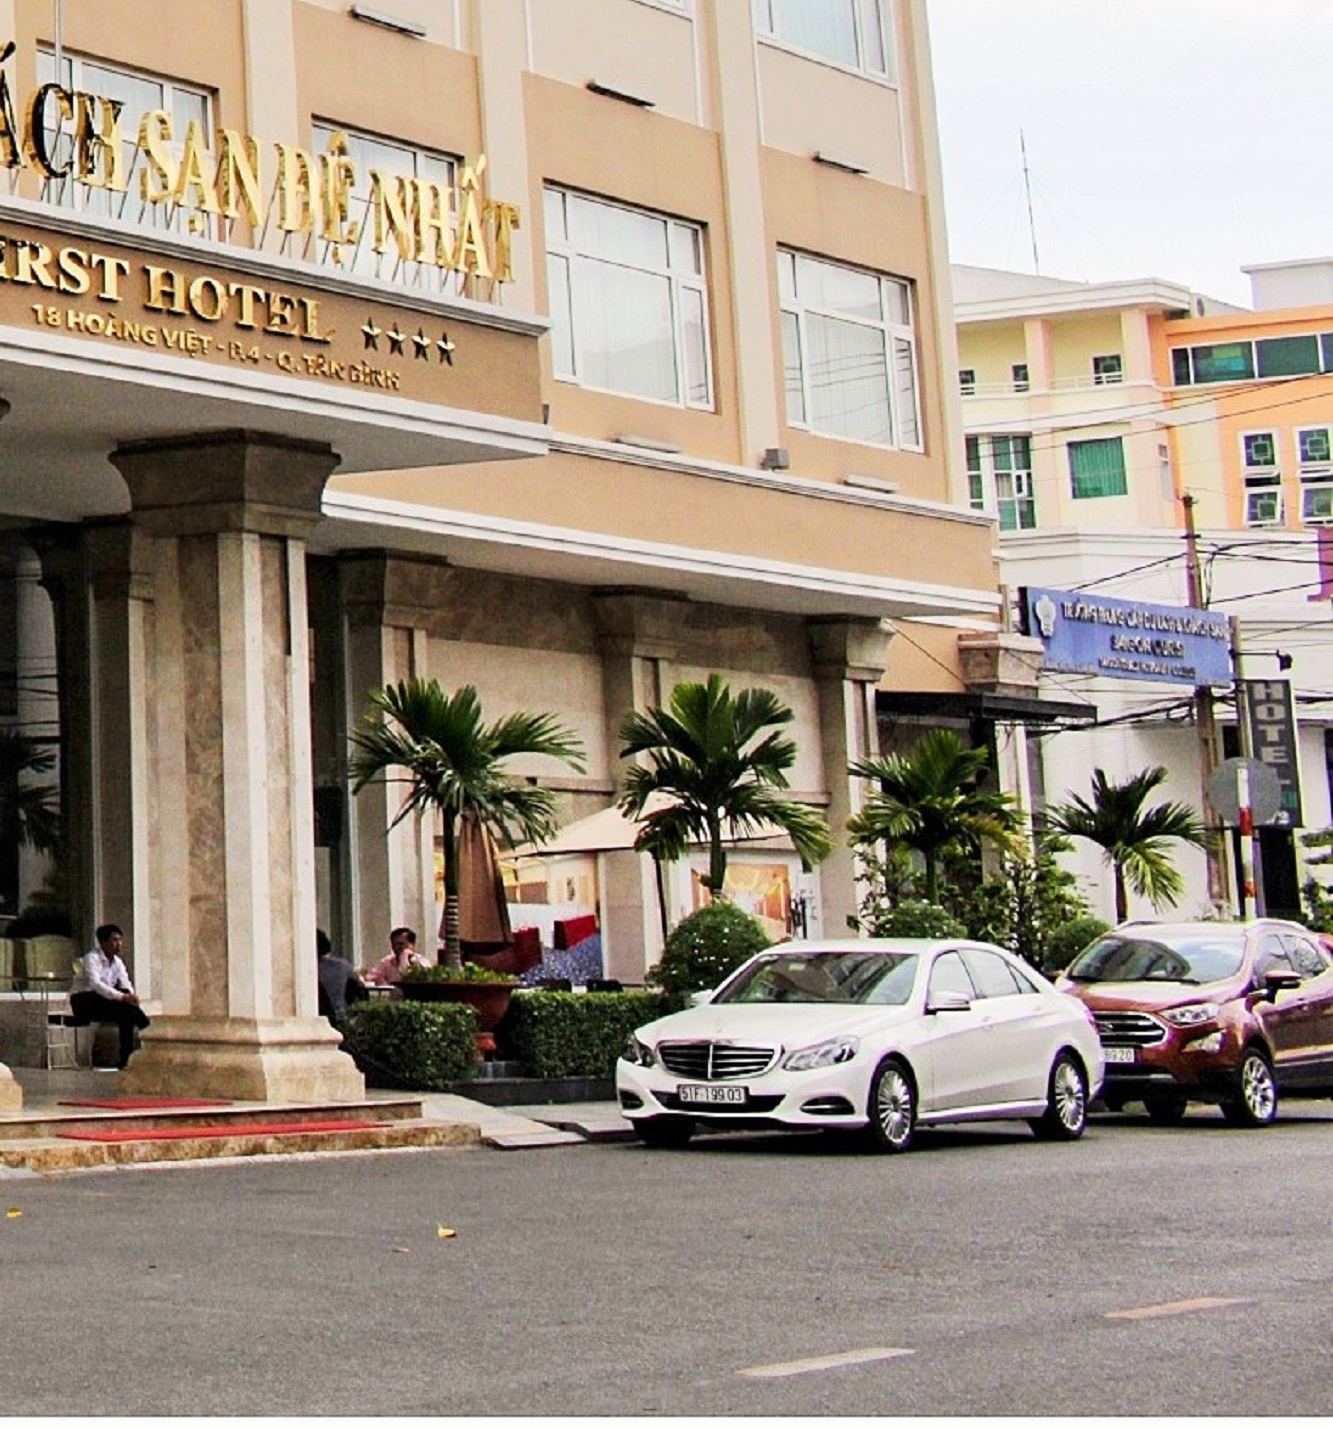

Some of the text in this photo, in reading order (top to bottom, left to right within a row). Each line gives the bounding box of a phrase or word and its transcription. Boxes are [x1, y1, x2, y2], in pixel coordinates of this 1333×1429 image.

[139, 109, 263, 233] SẠN
[275, 131, 356, 265] ĐỆ
[370, 153, 521, 283] NHẤT
[31, 304, 62, 327] 18
[67, 309, 157, 344] HOÀNG
[162, 328, 212, 357] VIỆT
[144, 266, 334, 343] HOTEL
[1253, 683, 1291, 784] HOTE
